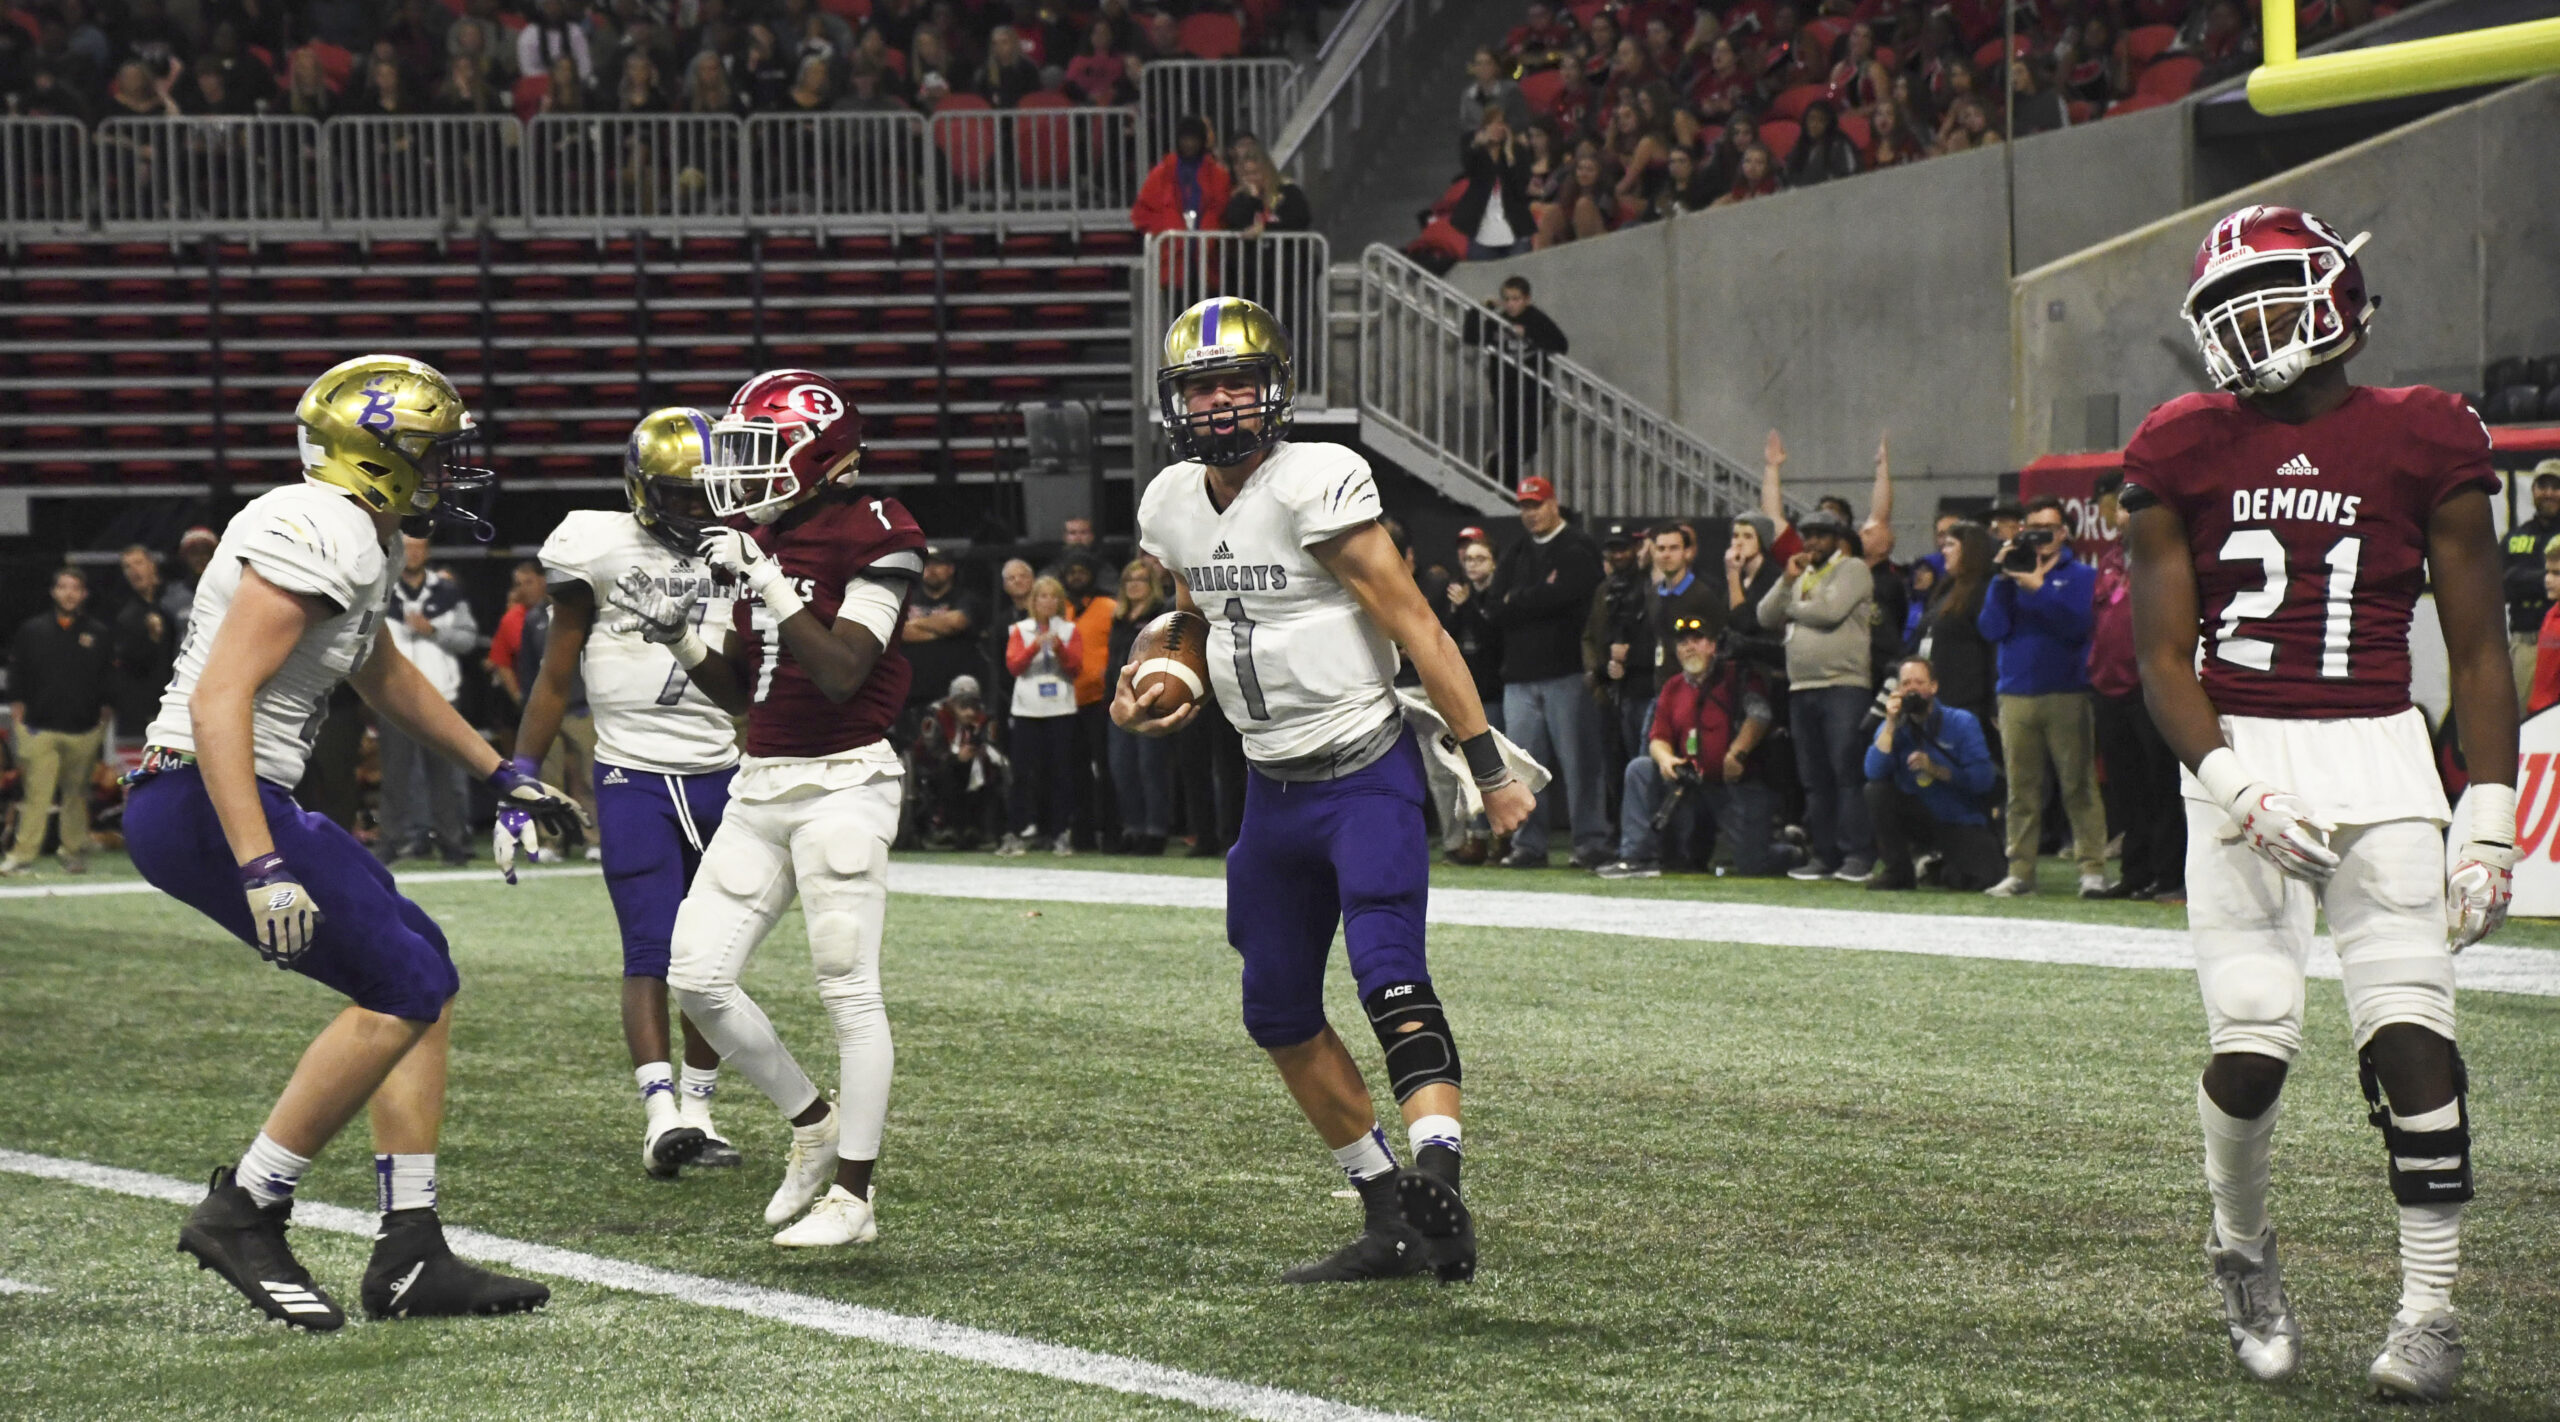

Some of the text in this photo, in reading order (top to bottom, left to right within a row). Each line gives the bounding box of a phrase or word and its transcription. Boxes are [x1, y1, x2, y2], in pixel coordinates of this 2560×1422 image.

[356, 389, 396, 430] B
[796, 388, 839, 417] R
[2276, 466, 2320, 476] adidas
[868, 500, 892, 530] 7
[2232, 487, 2362, 527] DEMONS
[1211, 552, 1234, 560] adidas
[1184, 564, 1288, 592] BEARCATS
[2215, 528, 2361, 678] 21
[1223, 596, 1271, 722] 1
[1384, 984, 1414, 999] ACE
